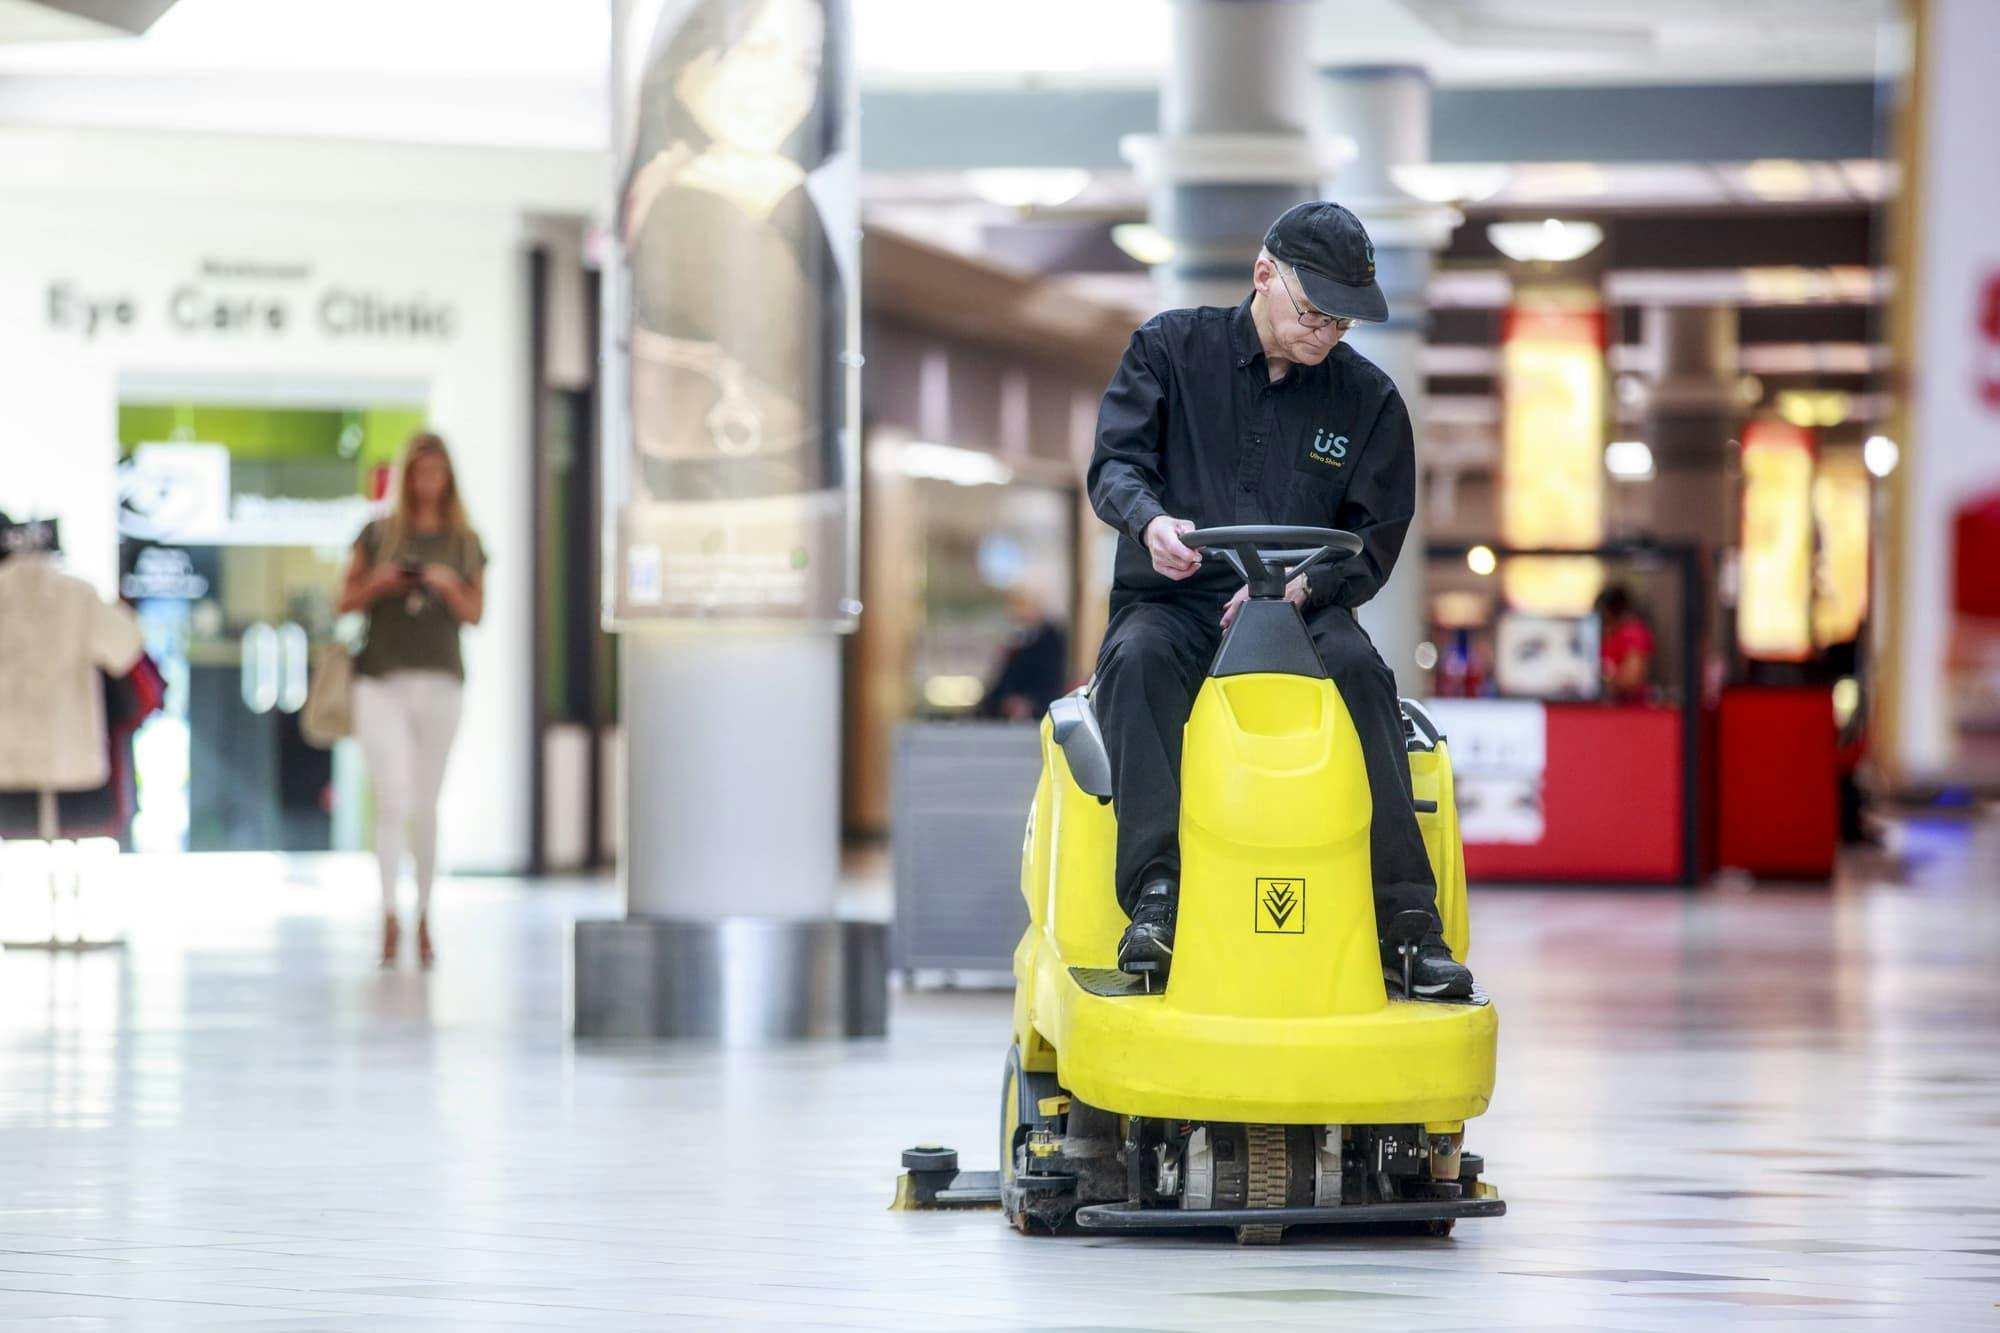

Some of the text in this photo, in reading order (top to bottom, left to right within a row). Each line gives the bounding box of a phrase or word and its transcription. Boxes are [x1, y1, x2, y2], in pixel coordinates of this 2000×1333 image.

[47, 279, 454, 339] Eye Care Clinic
